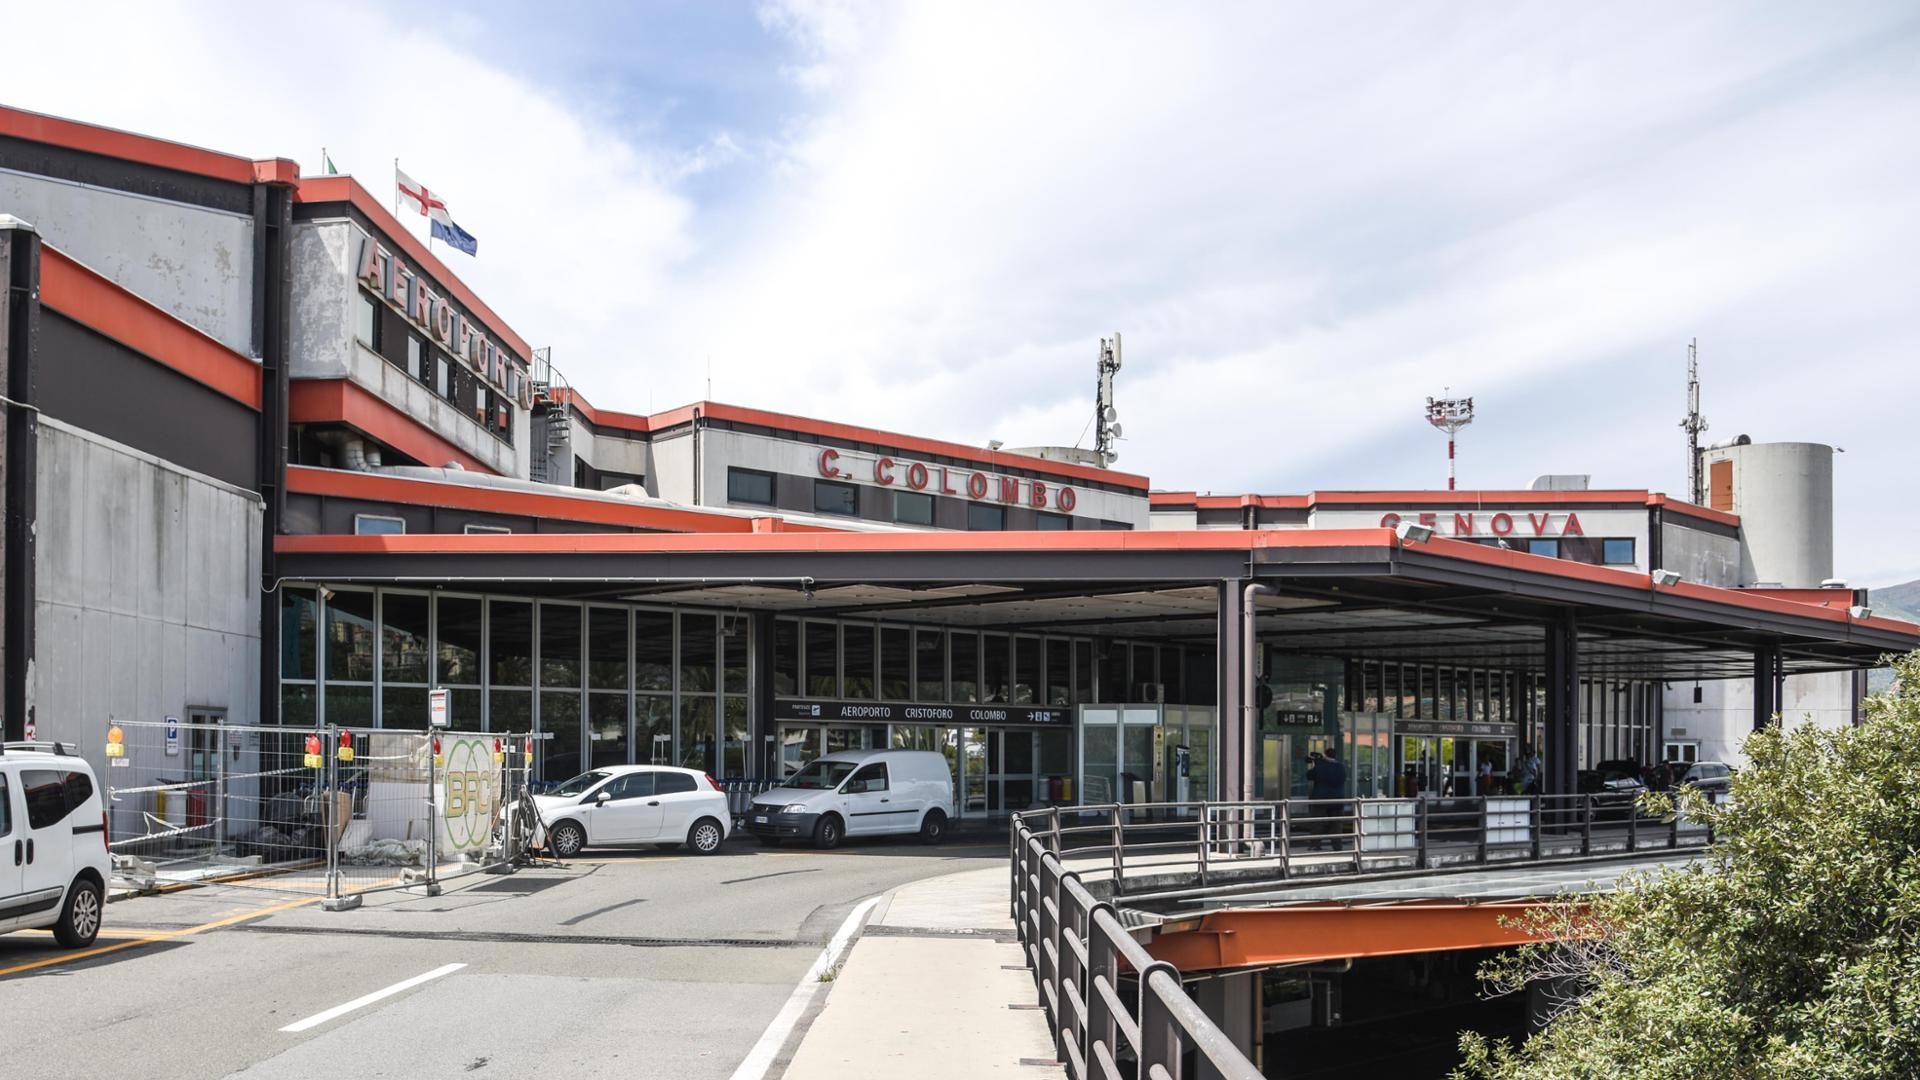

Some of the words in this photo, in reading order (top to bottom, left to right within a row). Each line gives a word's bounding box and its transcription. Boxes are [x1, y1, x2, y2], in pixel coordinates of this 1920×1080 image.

[358, 237, 535, 411] AEROPORTO
[818, 449, 852, 479] C.
[874, 457, 1077, 512] COLOMBO
[840, 706, 891, 718] AEROPORTO
[905, 707, 953, 719] CRISTOFORO
[970, 709, 1007, 721] COLOMBO
